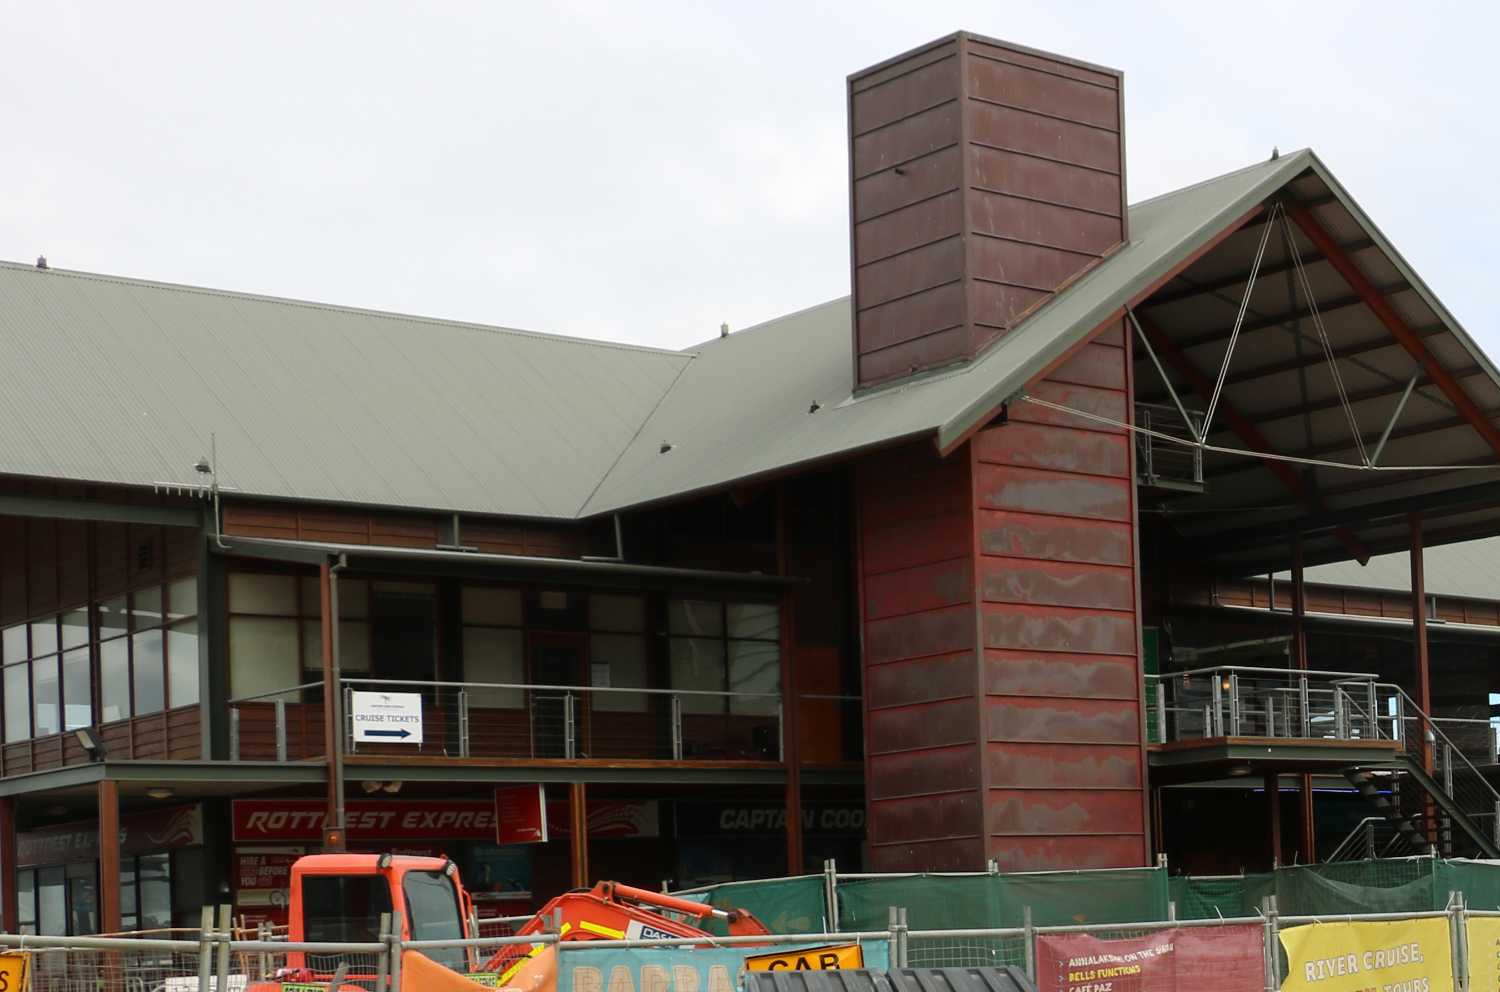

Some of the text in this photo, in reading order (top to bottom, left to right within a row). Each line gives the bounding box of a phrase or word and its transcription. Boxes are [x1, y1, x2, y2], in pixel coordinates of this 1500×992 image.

[246, 811, 394, 832] ROTTEST
[720, 808, 865, 829] CAPTAN COO
[1124, 953, 1138, 963] ON
[1138, 949, 1154, 960] THE
[1305, 943, 1424, 982] RIVER CRUISE,
[1069, 970, 1095, 982] BELLS
[1094, 982, 1113, 992] PAZ
